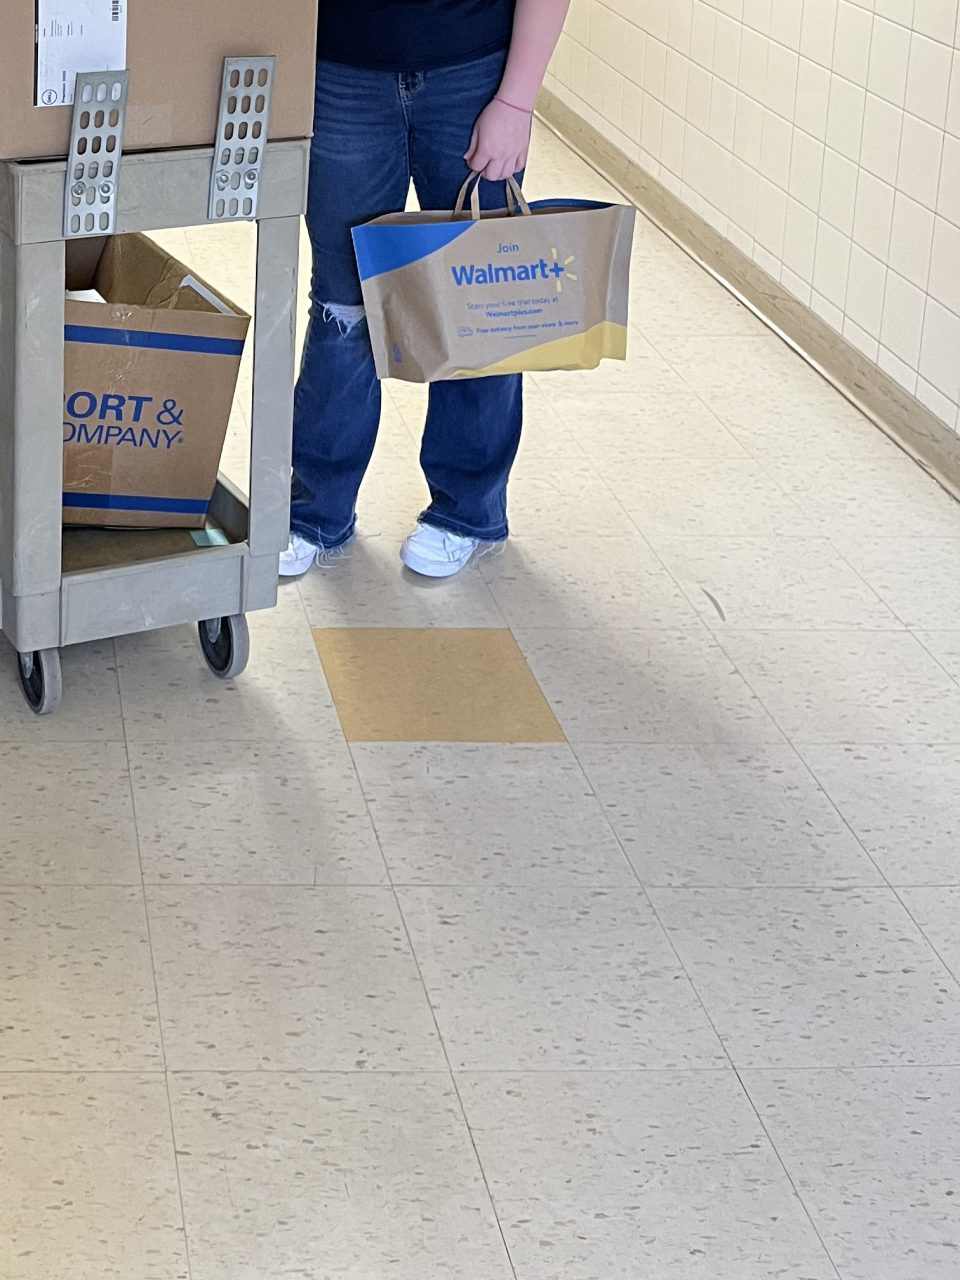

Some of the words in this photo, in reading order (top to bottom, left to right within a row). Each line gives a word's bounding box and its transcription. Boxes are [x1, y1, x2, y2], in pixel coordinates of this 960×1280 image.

[497, 243, 519, 253] Join
[64, 391, 153, 422] ORT
[156, 398, 184, 425] &
[63, 422, 182, 449] OMPANY
